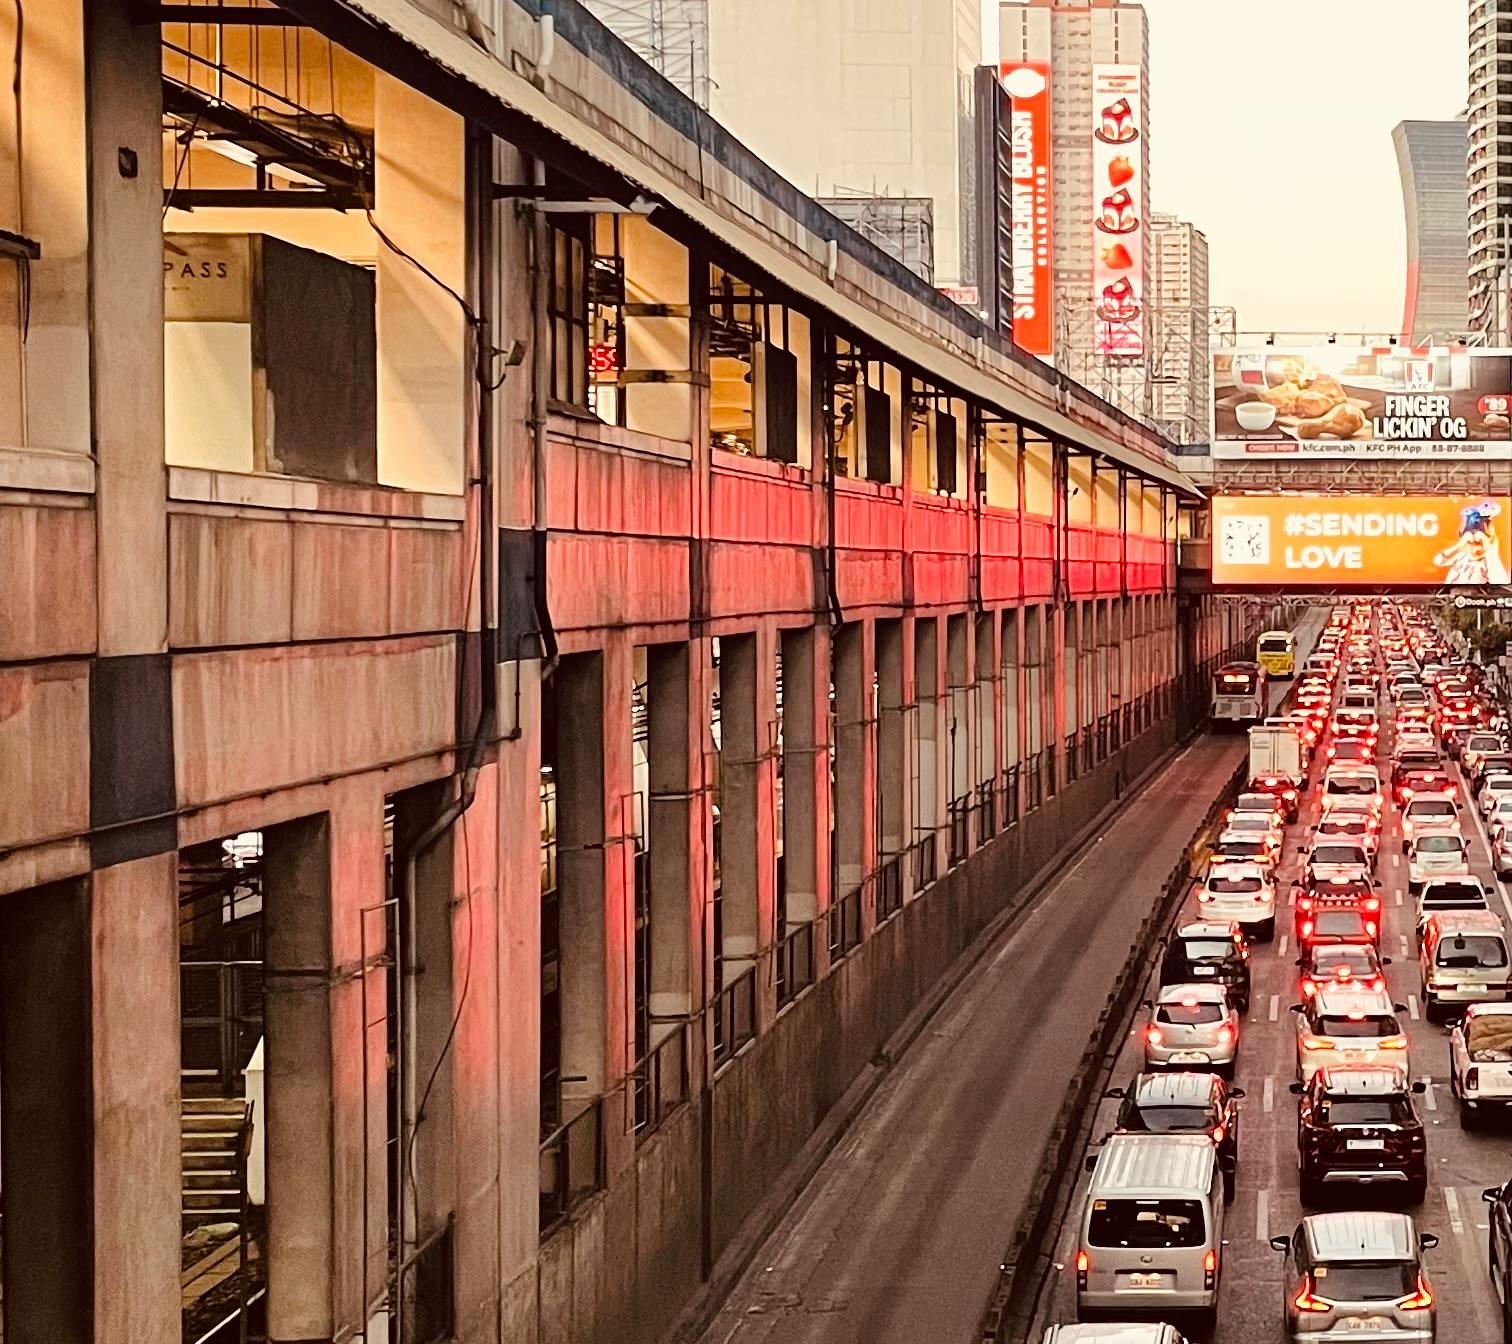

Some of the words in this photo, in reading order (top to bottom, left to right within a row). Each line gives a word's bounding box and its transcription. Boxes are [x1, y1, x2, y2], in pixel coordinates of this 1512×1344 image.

[1385, 395, 1451, 417] FINGER
[1440, 416, 1468, 439] OG
[1366, 443, 1384, 453] KFC
[1386, 443, 1400, 453] PH
[1402, 443, 1422, 455] App
[1284, 513, 1440, 537] #SENDING
[1285, 545, 1364, 569] LOVE
